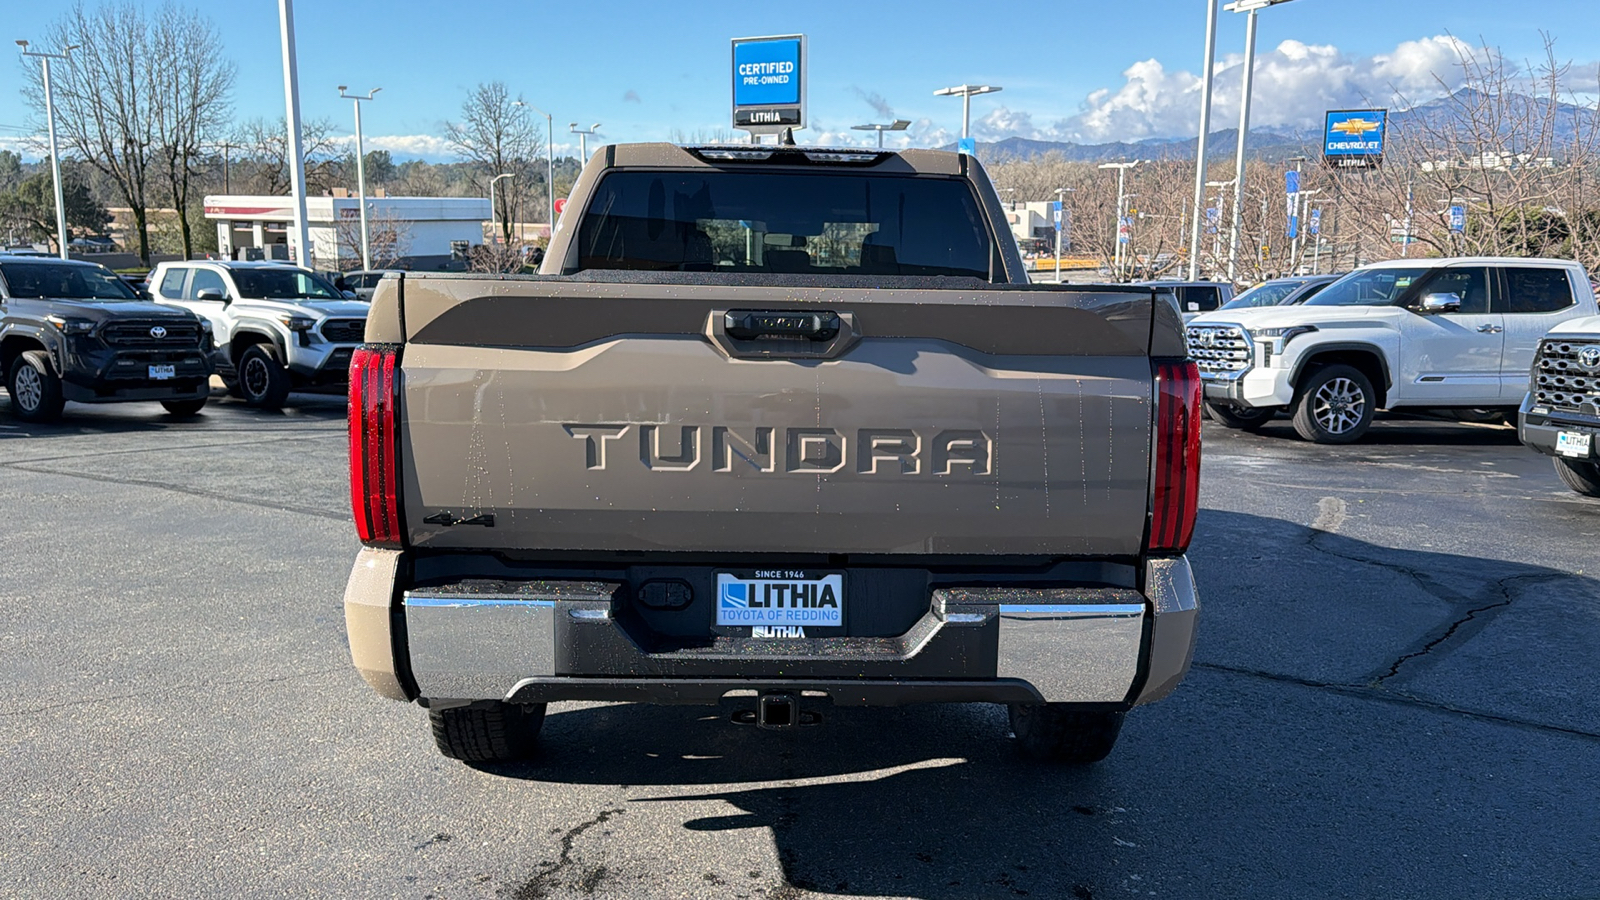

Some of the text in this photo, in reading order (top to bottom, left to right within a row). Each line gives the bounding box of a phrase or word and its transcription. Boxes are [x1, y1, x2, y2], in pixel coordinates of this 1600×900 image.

[739, 61, 794, 75] CERTIFIED
[743, 75, 789, 85] PRE-OWNED
[750, 112, 781, 122] LITHIA
[1328, 141, 1380, 150] CHEVROLET
[1338, 158, 1366, 167] LITHIA
[1566, 435, 1589, 447] LITHIA
[562, 423, 993, 475] TUNDRA
[749, 584, 838, 608] LITHIA
[721, 610, 839, 620] TOYOTA OF REDDING
[764, 626, 806, 638] LITHIA
